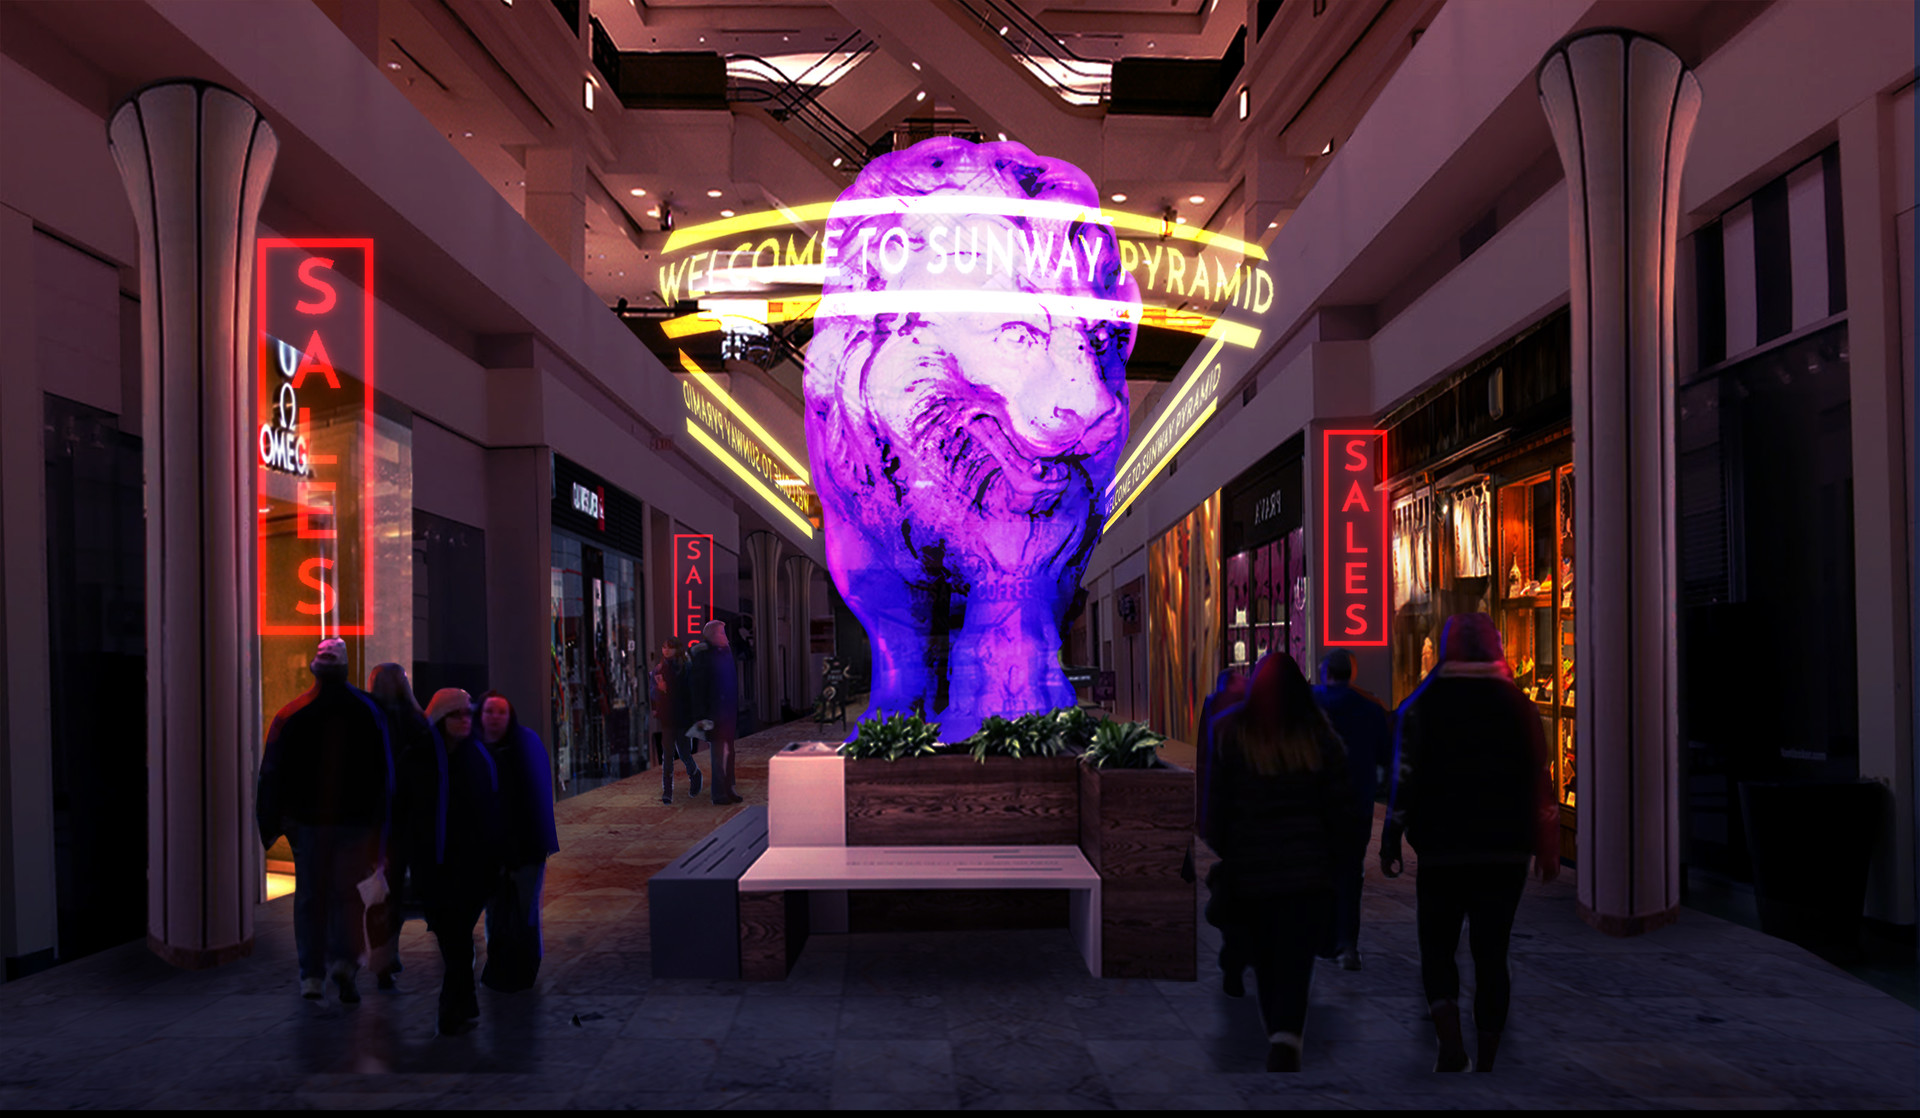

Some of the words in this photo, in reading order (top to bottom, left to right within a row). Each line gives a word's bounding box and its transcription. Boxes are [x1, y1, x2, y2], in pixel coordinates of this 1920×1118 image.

[660, 230, 844, 307] WELCOME
[857, 227, 910, 275] TO
[926, 225, 1103, 282] SUNWAY
[1118, 239, 1274, 315] PYRAMID
[292, 256, 341, 615] SALES
[1131, 462, 1141, 487] TO
[1141, 418, 1175, 475] SUNWAY
[1175, 362, 1221, 436] PYRAMID
[977, 579, 1033, 600] COFFEE
[1342, 439, 1370, 636] SALES
